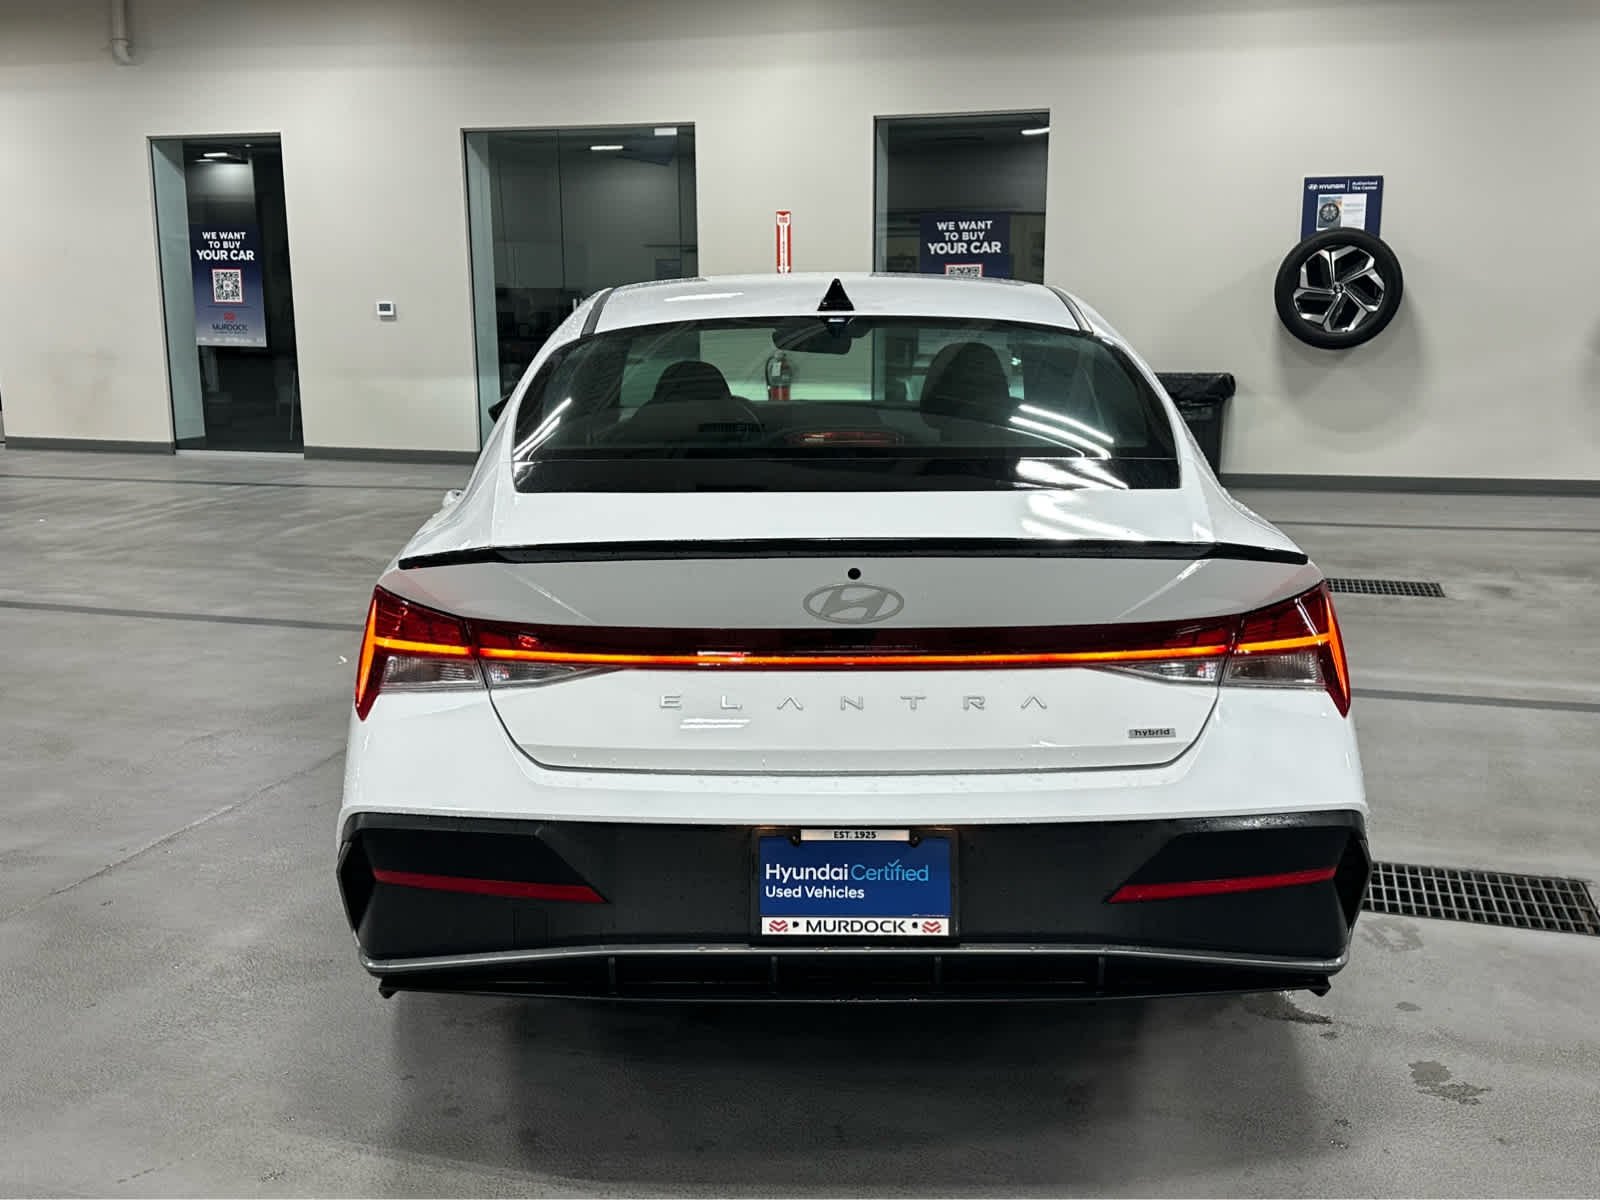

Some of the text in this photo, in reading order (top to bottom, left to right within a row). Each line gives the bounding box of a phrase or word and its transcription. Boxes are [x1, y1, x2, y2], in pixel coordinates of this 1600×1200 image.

[936, 220, 993, 231] WE WANT
[202, 231, 246, 240] WE WANT
[943, 231, 985, 240] TO BUY
[208, 240, 241, 249] TO BUY
[927, 241, 1002, 255] YOUR CAR
[196, 249, 255, 261] YOUR CAR
[659, 695, 1048, 711] ELANTRA
[1134, 728, 1170, 737] hybrid
[833, 831, 877, 839] EST. 1925
[765, 860, 929, 883] Hyundai Certified
[765, 885, 865, 899] Used Vehicles
[806, 919, 907, 933] MURDOCK
